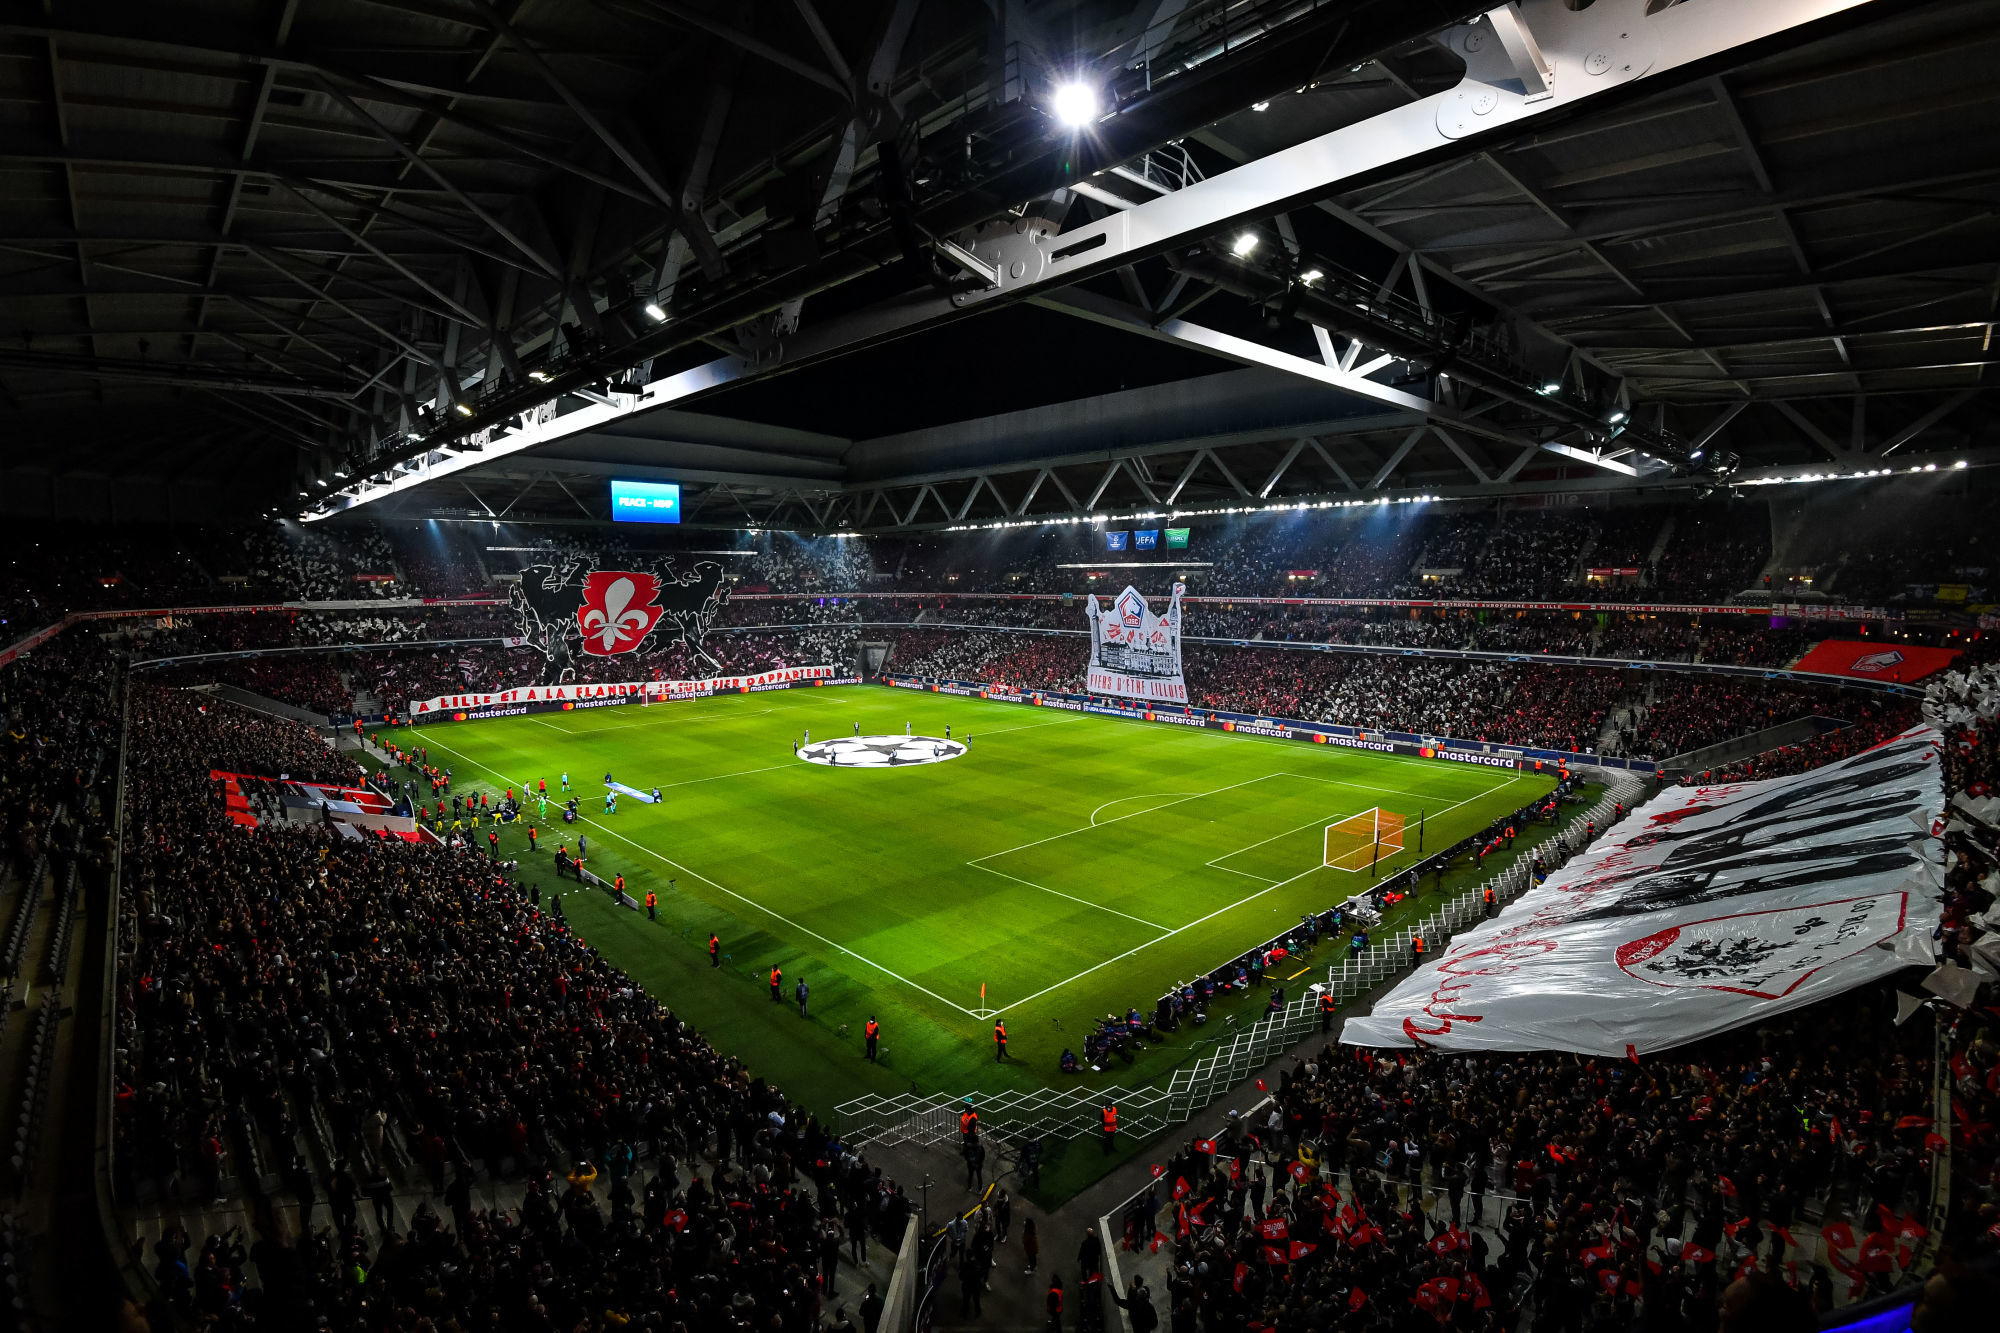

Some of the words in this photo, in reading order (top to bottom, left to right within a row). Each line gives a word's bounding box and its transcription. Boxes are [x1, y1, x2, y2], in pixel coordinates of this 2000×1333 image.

[1135, 536, 1155, 545] UEFA
[750, 683, 790, 692] mastercard
[895, 681, 924, 690] mastercard
[939, 686, 970, 696] mastercard
[1090, 674, 1112, 690] FIERS
[1150, 681, 1185, 699] LILLOIS
[440, 695, 491, 708] LILLE
[500, 690, 518, 702] ET
[546, 687, 566, 699] LA
[657, 682, 671, 693] JE
[677, 682, 706, 693] SUIS
[712, 678, 740, 689] FIER
[668, 690, 713, 700] mastercard
[988, 693, 1022, 703] mastercard
[575, 698, 627, 709] mastercard
[1042, 700, 1081, 711] mastercard
[469, 706, 527, 719] mastercard
[1156, 714, 1205, 727] mastercard
[1236, 724, 1293, 739] mastercard
[1328, 735, 1394, 753] mastercard
[1437, 749, 1514, 768] mastercard
